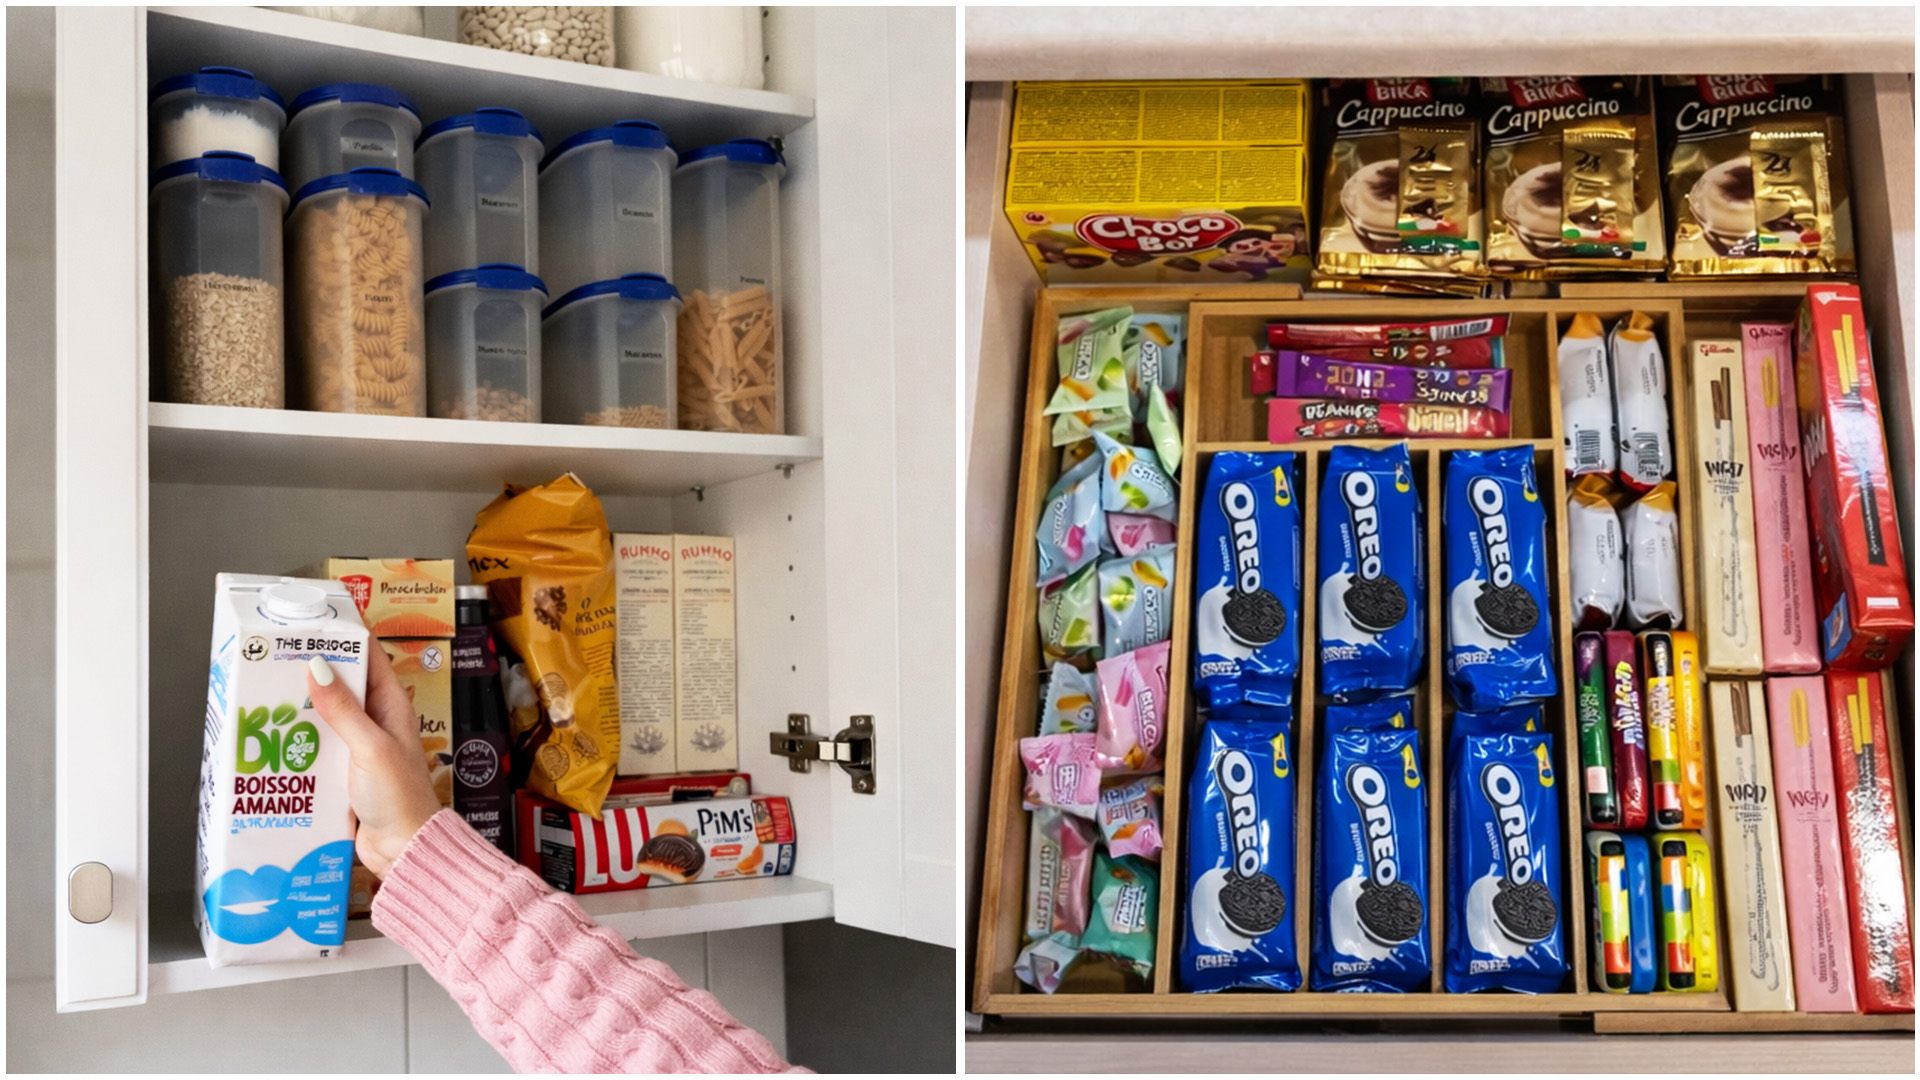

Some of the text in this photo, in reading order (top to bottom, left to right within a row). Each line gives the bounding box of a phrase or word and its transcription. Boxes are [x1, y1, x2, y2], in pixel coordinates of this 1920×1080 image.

[1336, 98, 1466, 128] Cappuccino
[1376, 84, 1430, 101] BIKA
[1487, 97, 1620, 135] Cappuccino
[1675, 94, 1813, 132] Cappuccino
[1224, 482, 1262, 594] OREO
[1345, 471, 1382, 581] OREO
[1473, 477, 1513, 589] OREO
[275, 637, 303, 650] THE
[231, 796, 314, 815] AMANDE
[234, 775, 316, 795] BOISSON
[1222, 751, 1260, 878] OREO
[578, 806, 646, 887] LU
[1352, 765, 1397, 887] OREO
[1487, 765, 1532, 886] OREO
